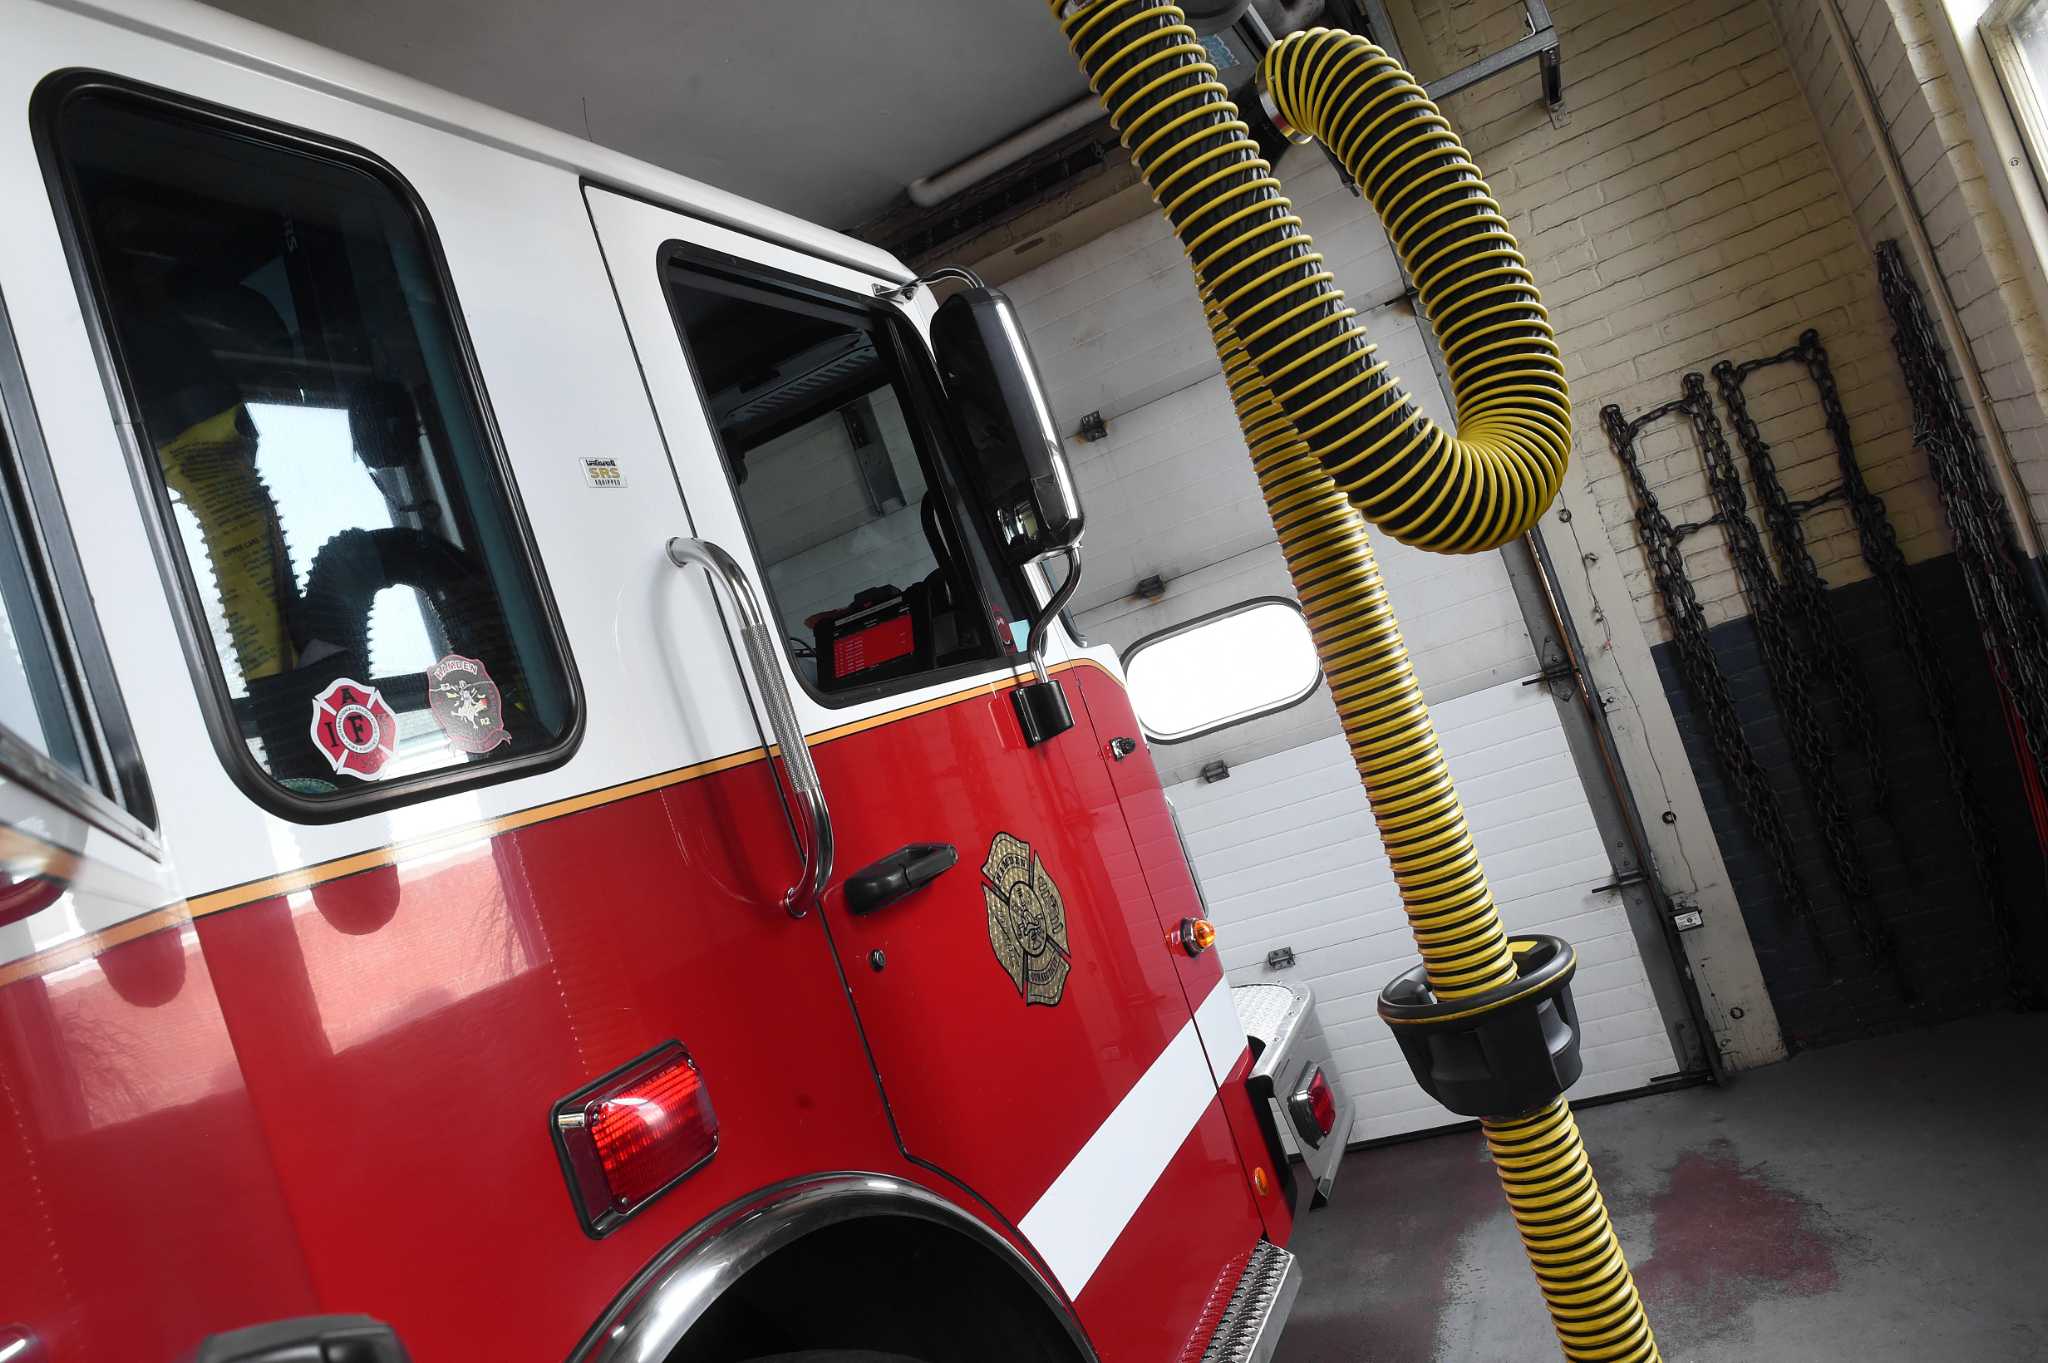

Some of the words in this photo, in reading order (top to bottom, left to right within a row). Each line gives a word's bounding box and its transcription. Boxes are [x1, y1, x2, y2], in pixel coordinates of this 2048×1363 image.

[589, 467, 621, 479] SRS
[434, 660, 478, 681] HAMDEN
[341, 688, 358, 705] A
[324, 721, 339, 748] I
[348, 714, 364, 744] F
[995, 856, 1026, 883] HAMDEN
